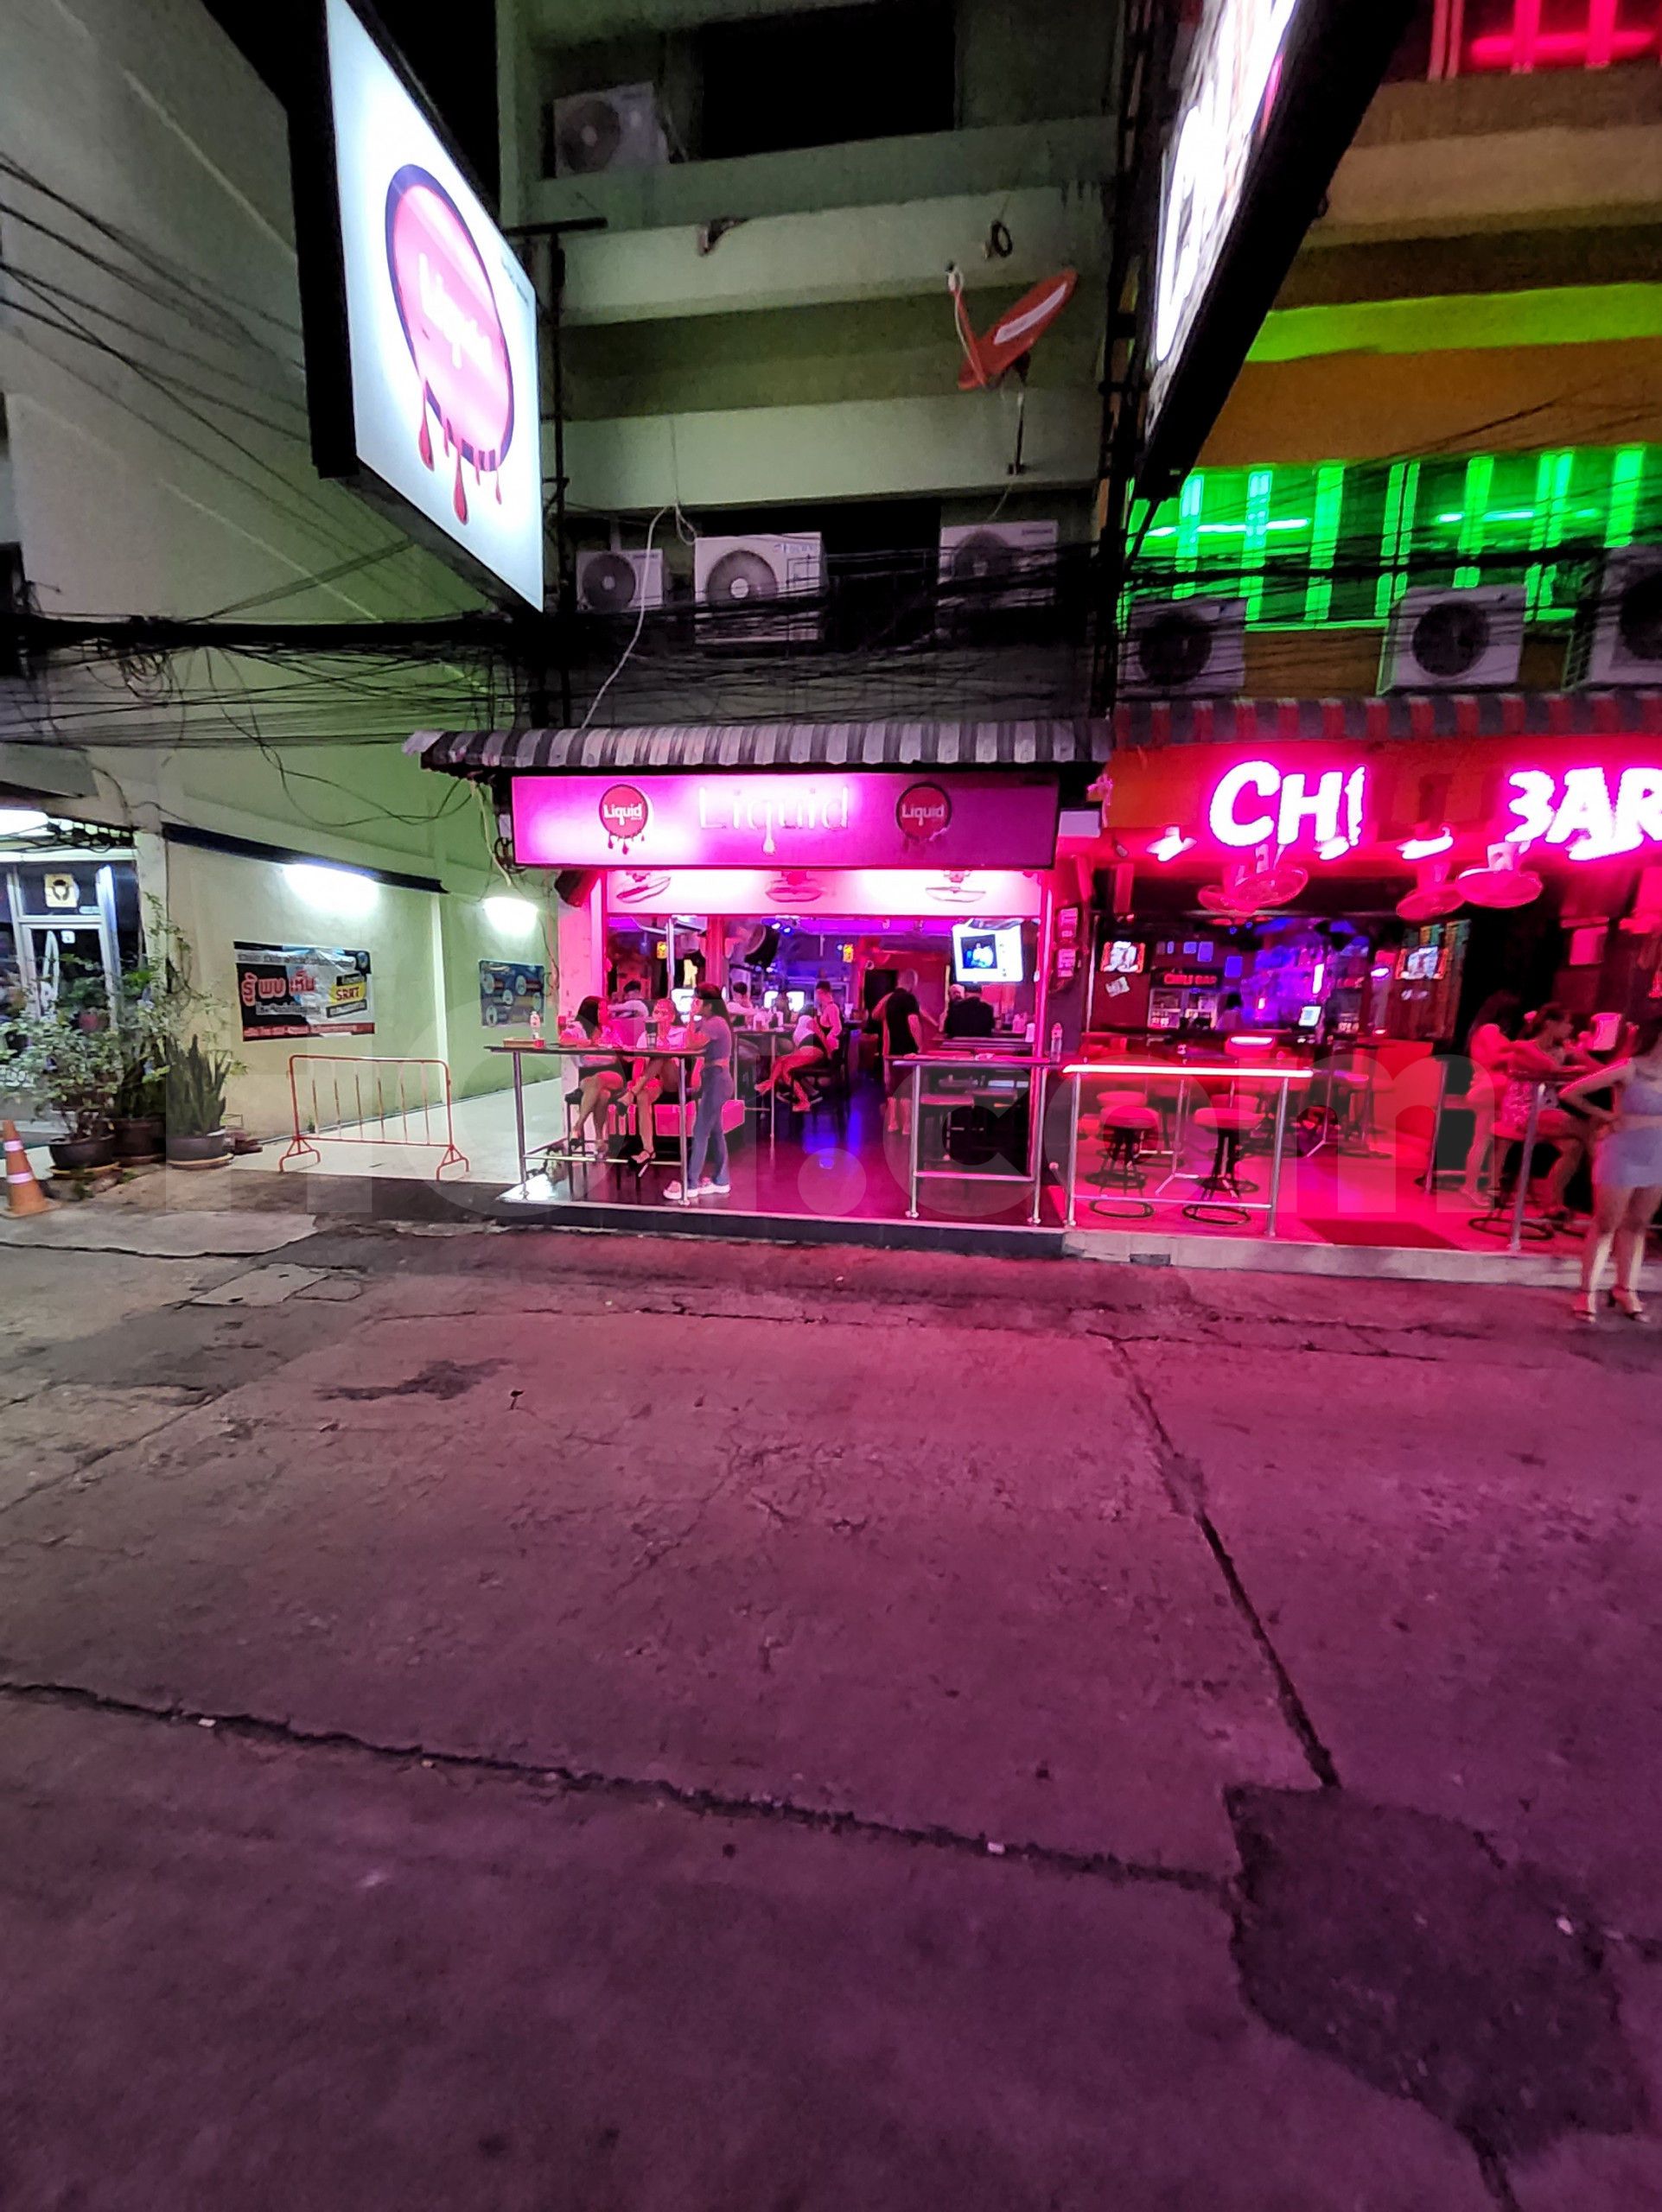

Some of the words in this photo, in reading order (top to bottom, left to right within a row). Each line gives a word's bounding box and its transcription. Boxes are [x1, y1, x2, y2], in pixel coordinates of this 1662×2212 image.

[602, 802, 644, 827] Liquid
[698, 785, 849, 857] Liquid
[901, 804, 946, 827] Liquid
